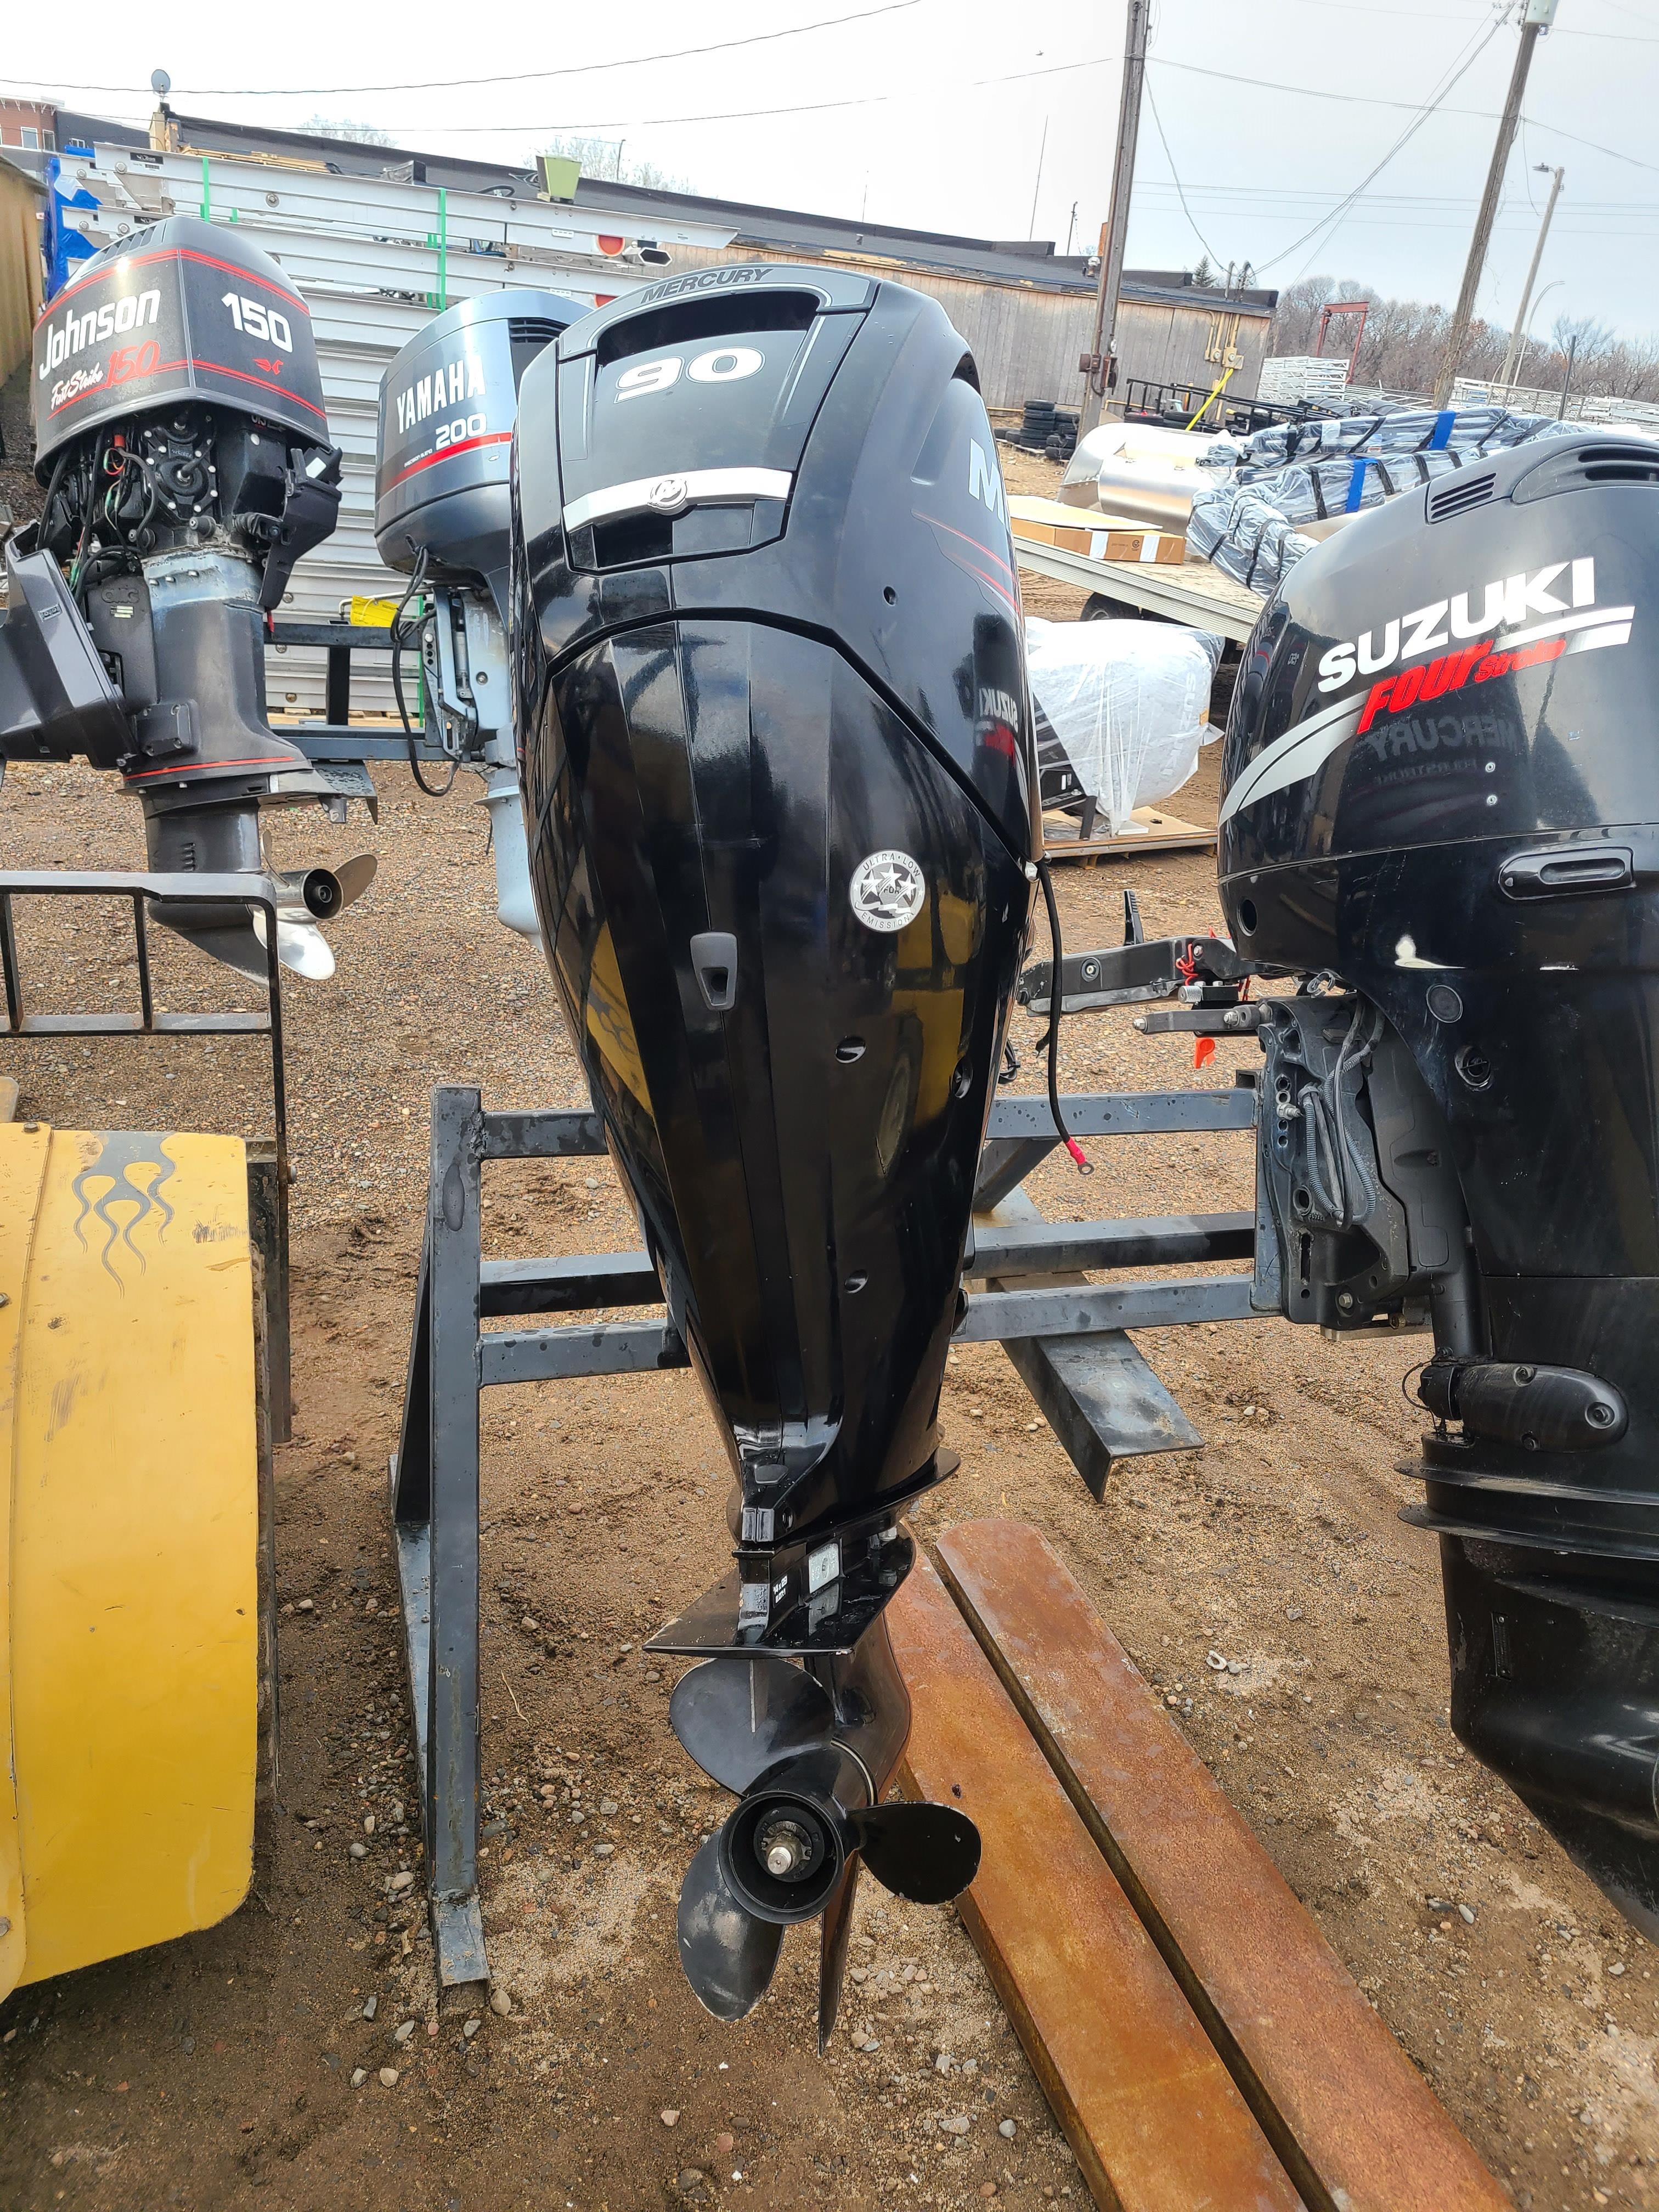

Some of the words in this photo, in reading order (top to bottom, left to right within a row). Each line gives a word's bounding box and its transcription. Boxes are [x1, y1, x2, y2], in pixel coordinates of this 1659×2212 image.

[640, 268, 774, 304] MERCURY
[40, 289, 161, 381] Johnson
[221, 292, 293, 353] 150
[106, 338, 161, 388] 150
[613, 346, 766, 405] 90
[396, 356, 487, 435] YAMAHA
[435, 413, 487, 450] 200
[1317, 557, 1595, 693] SUZUKI
[862, 853, 895, 871] ULTRA
[902, 857, 921, 878] LOW
[861, 912, 911, 929] EMISSION
